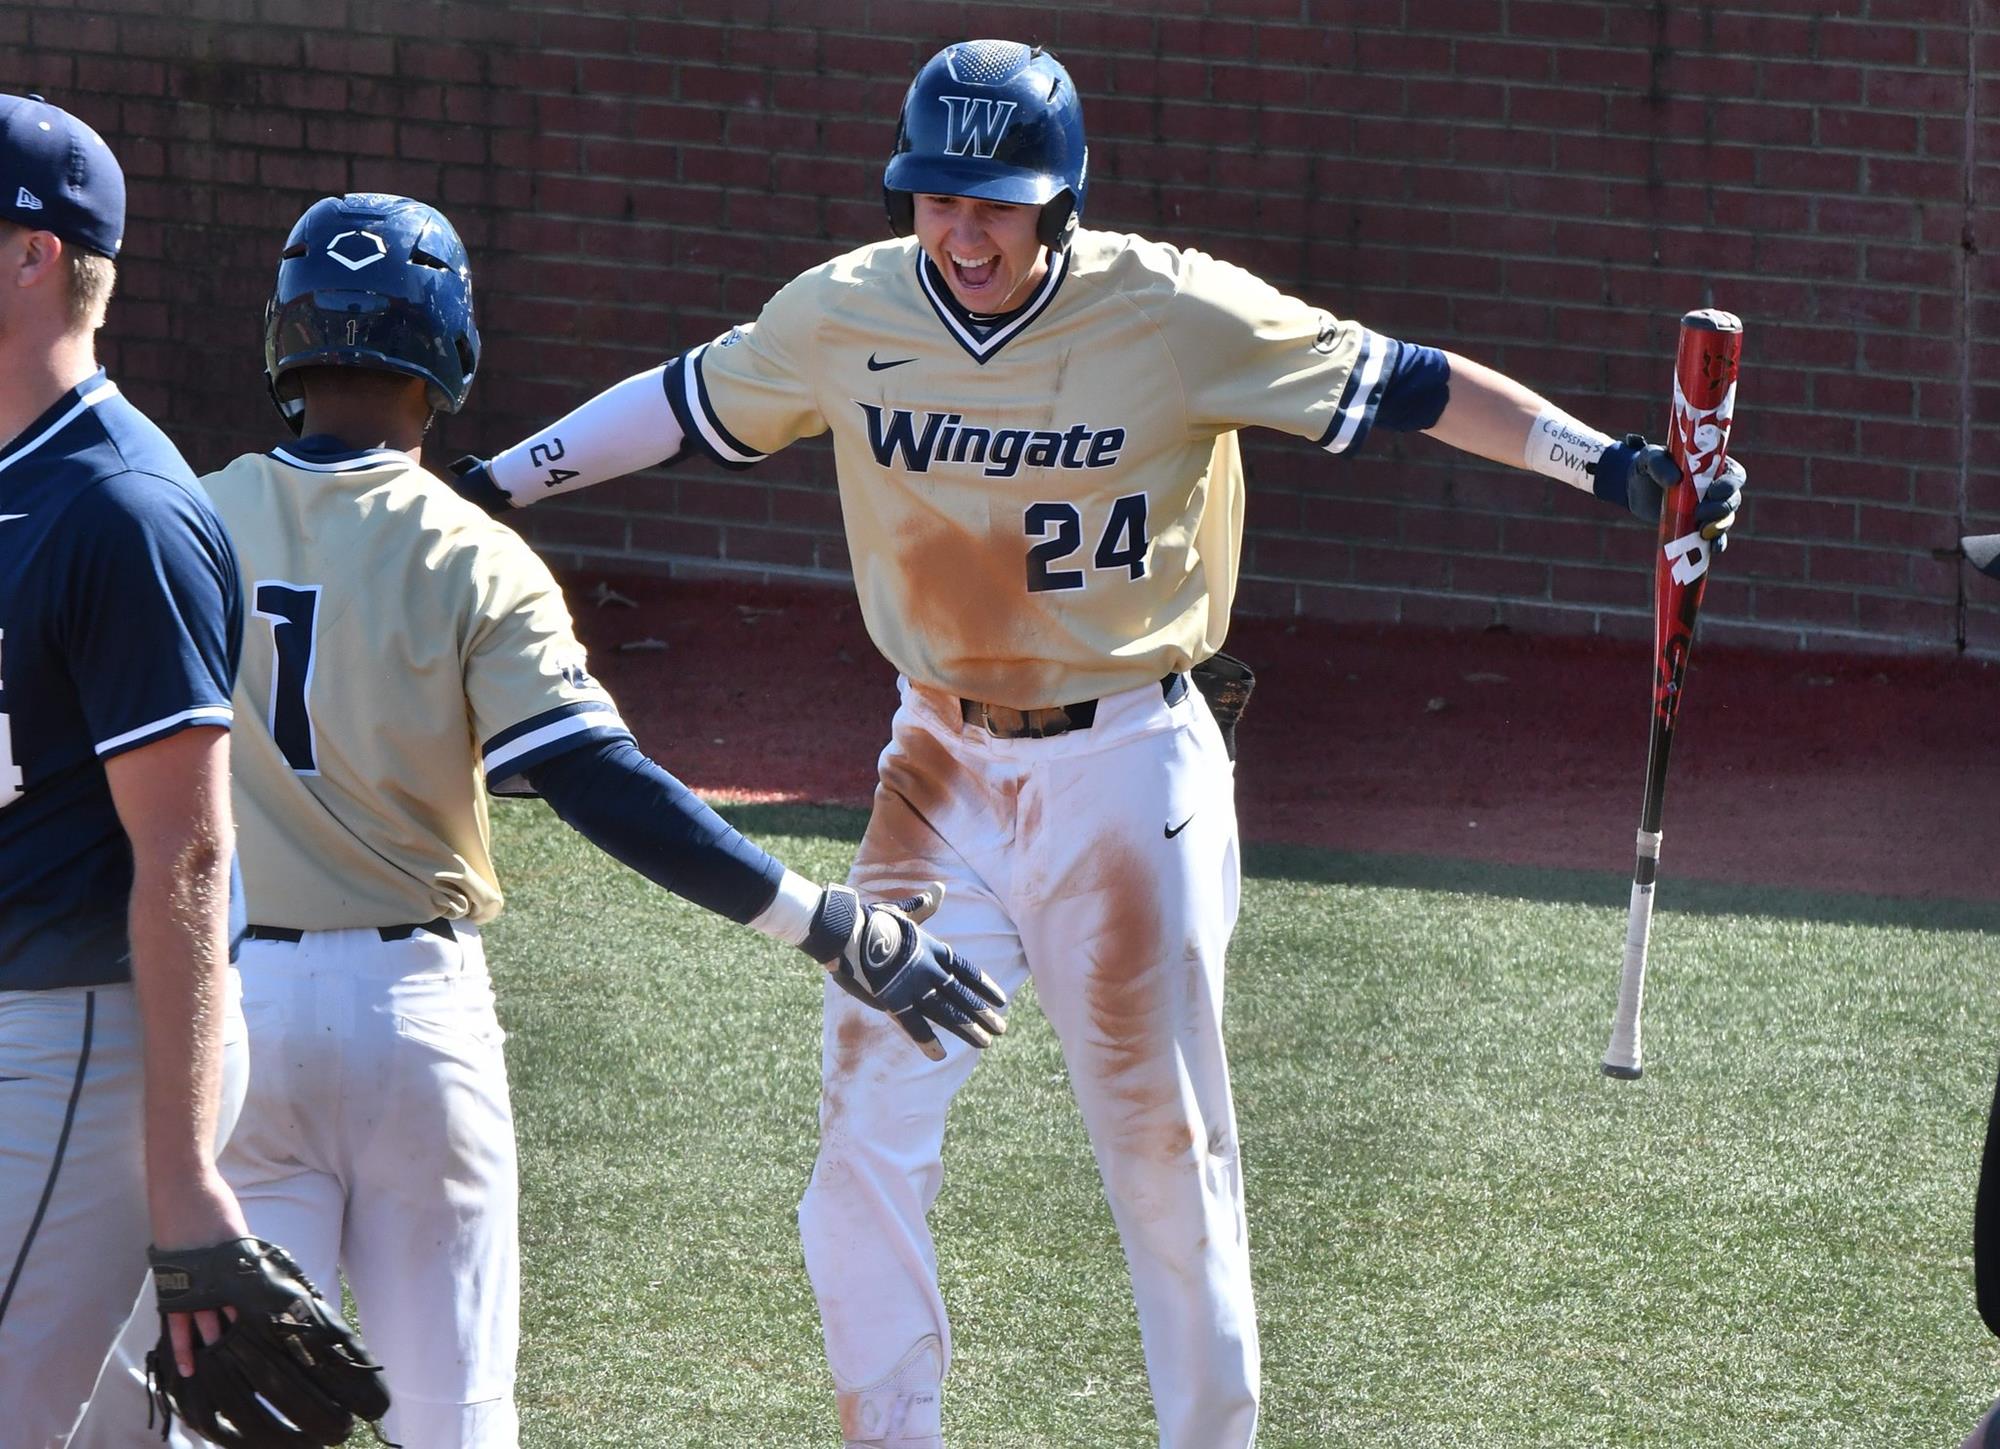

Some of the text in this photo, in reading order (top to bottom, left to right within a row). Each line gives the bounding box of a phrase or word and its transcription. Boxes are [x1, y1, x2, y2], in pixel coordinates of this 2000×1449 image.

[938, 95, 1018, 160] W
[346, 319, 356, 346] 1
[529, 437, 581, 488] 24
[854, 399, 1126, 478] Wingate
[1023, 491, 1149, 593] 24
[251, 579, 323, 777] 1
